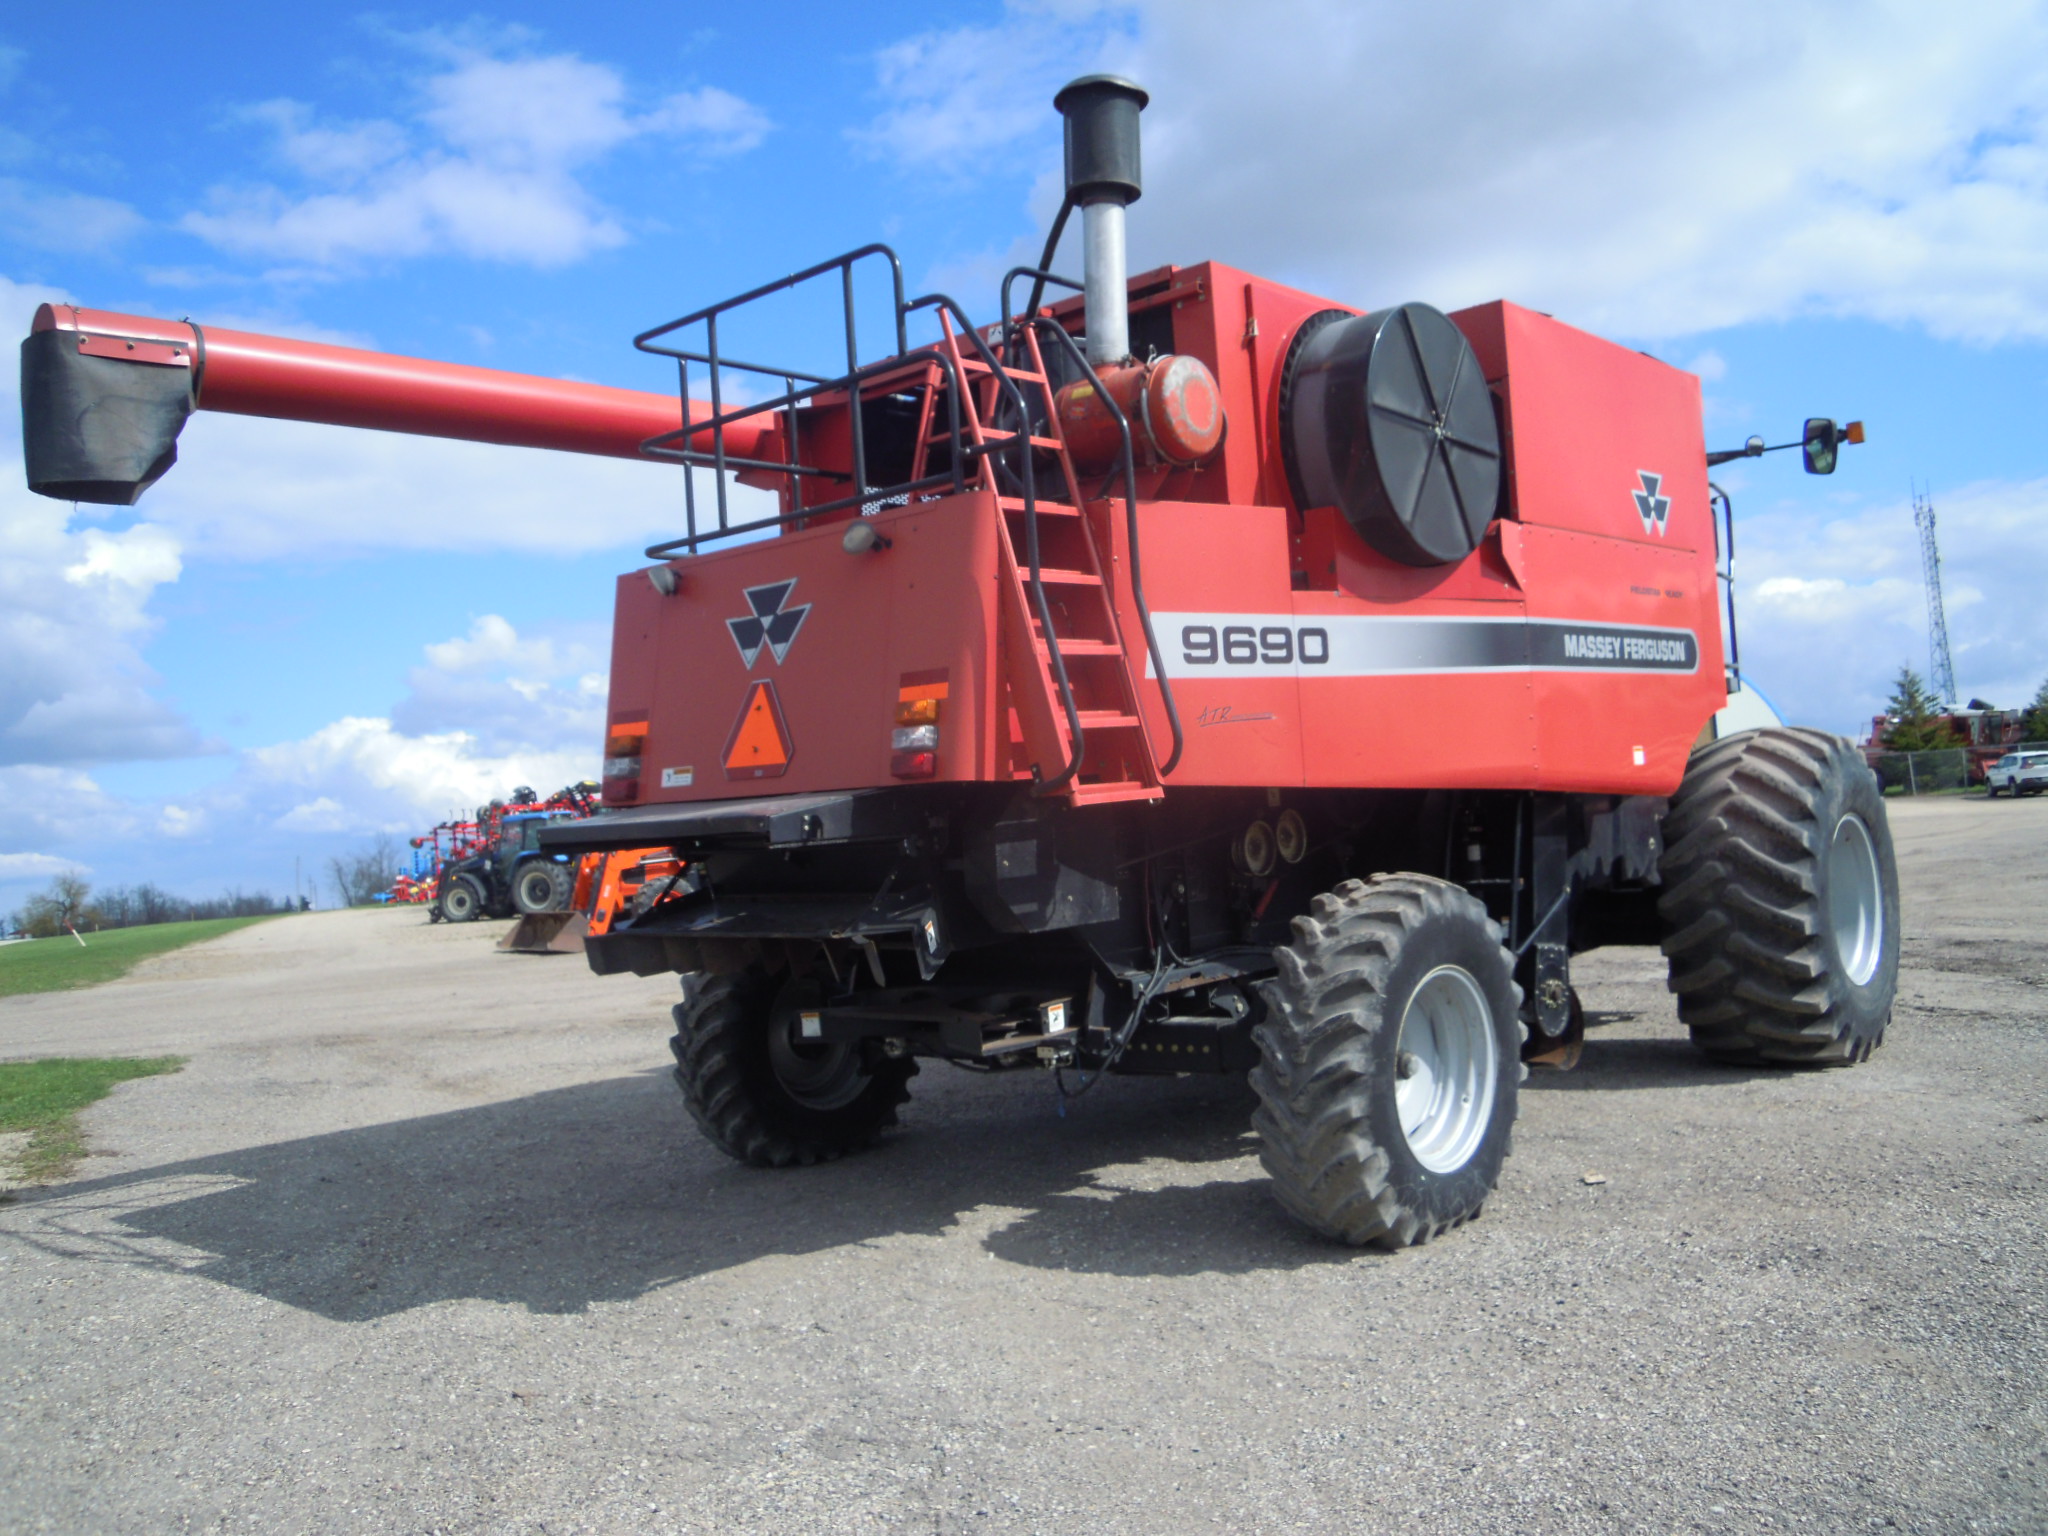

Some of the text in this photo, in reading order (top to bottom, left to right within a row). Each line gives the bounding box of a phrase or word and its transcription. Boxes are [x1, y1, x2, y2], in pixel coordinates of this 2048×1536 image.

[1181, 625, 1329, 664] 9690
[1564, 634, 1686, 662] MASSEY FERGUSON
